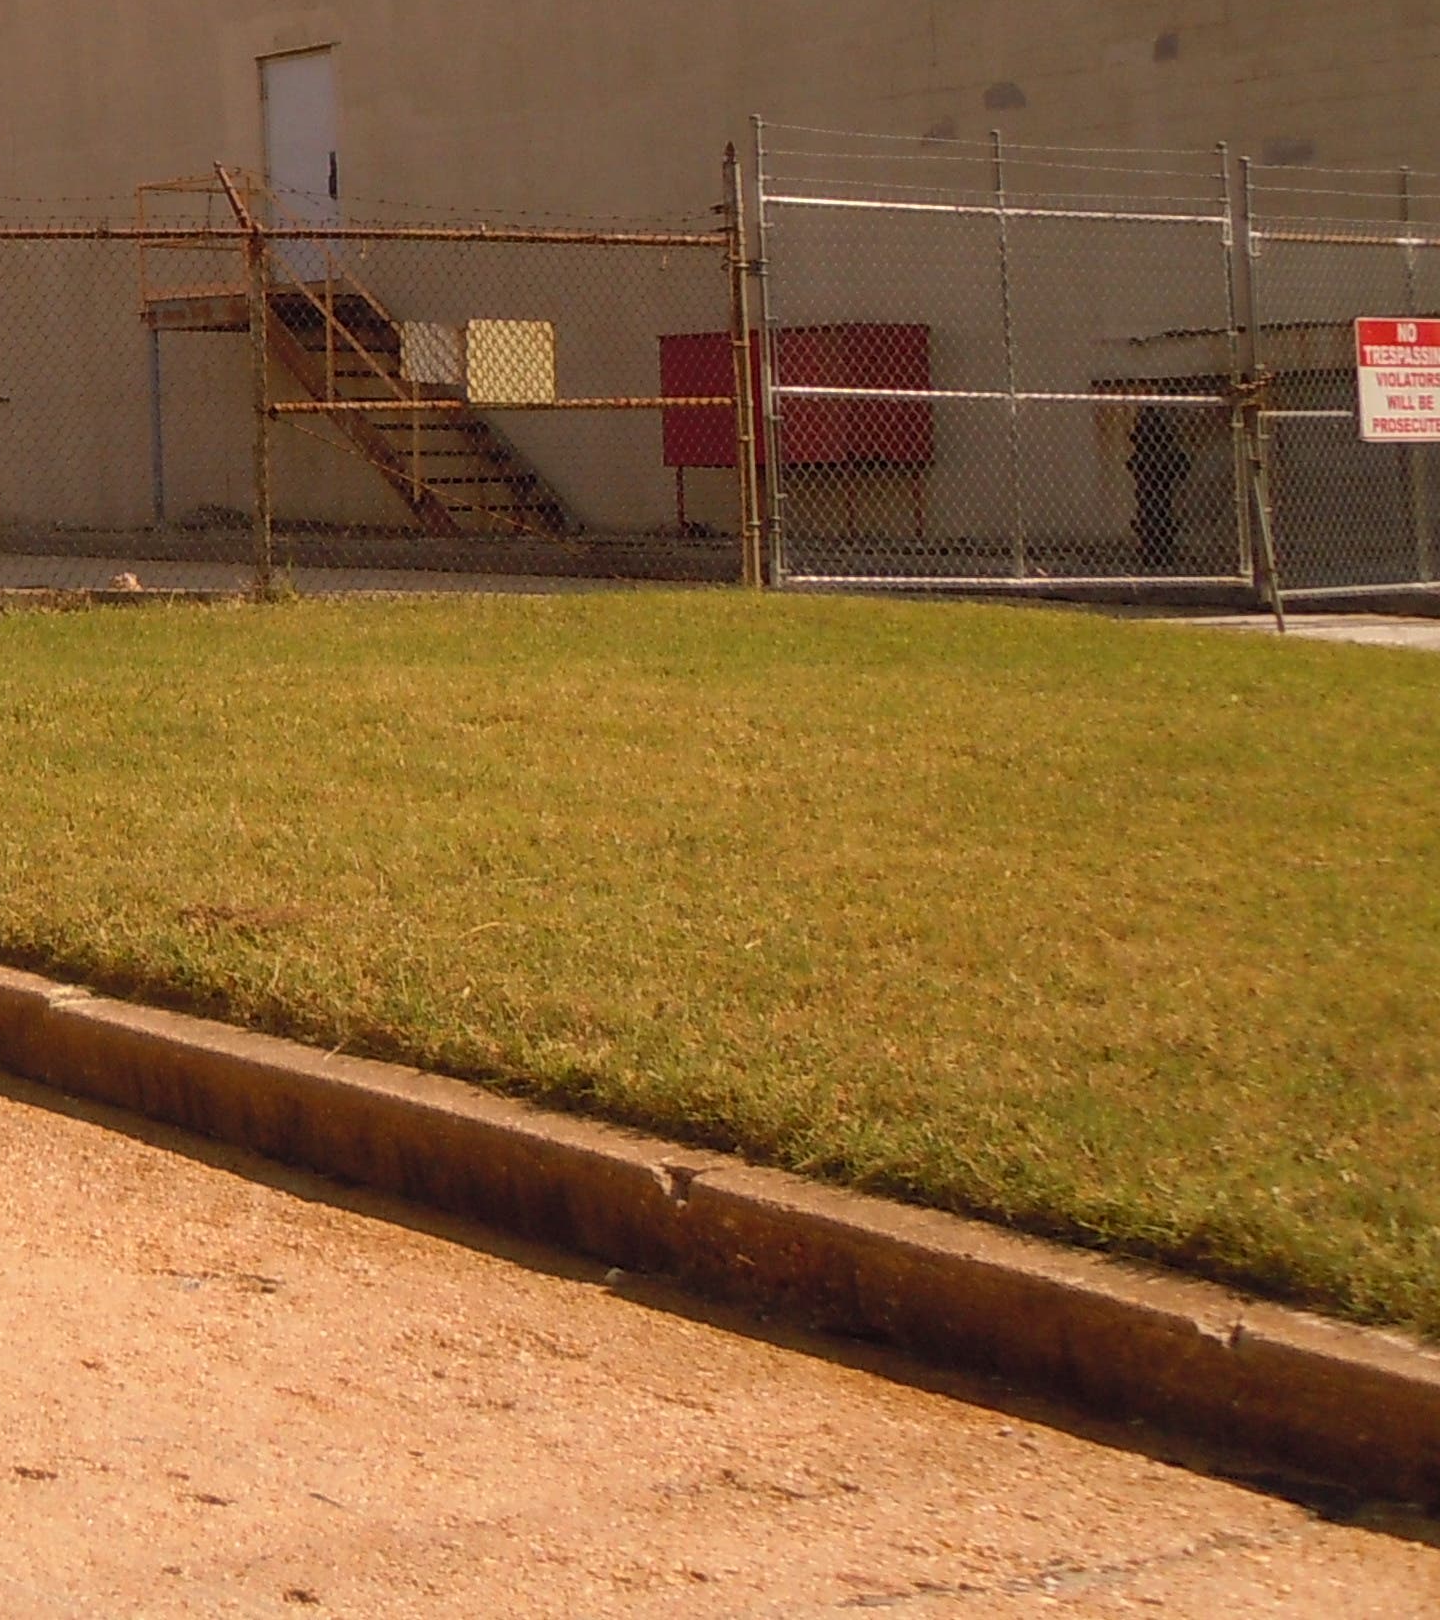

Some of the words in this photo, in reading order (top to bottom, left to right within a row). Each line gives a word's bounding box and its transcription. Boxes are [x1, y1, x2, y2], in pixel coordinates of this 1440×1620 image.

[1396, 323, 1418, 343] NO
[1363, 345, 1440, 365] TRESPASSIN
[1387, 395, 1415, 410] WILL
[1419, 395, 1434, 410] BE
[1372, 417, 1440, 433] PROSECUTE
